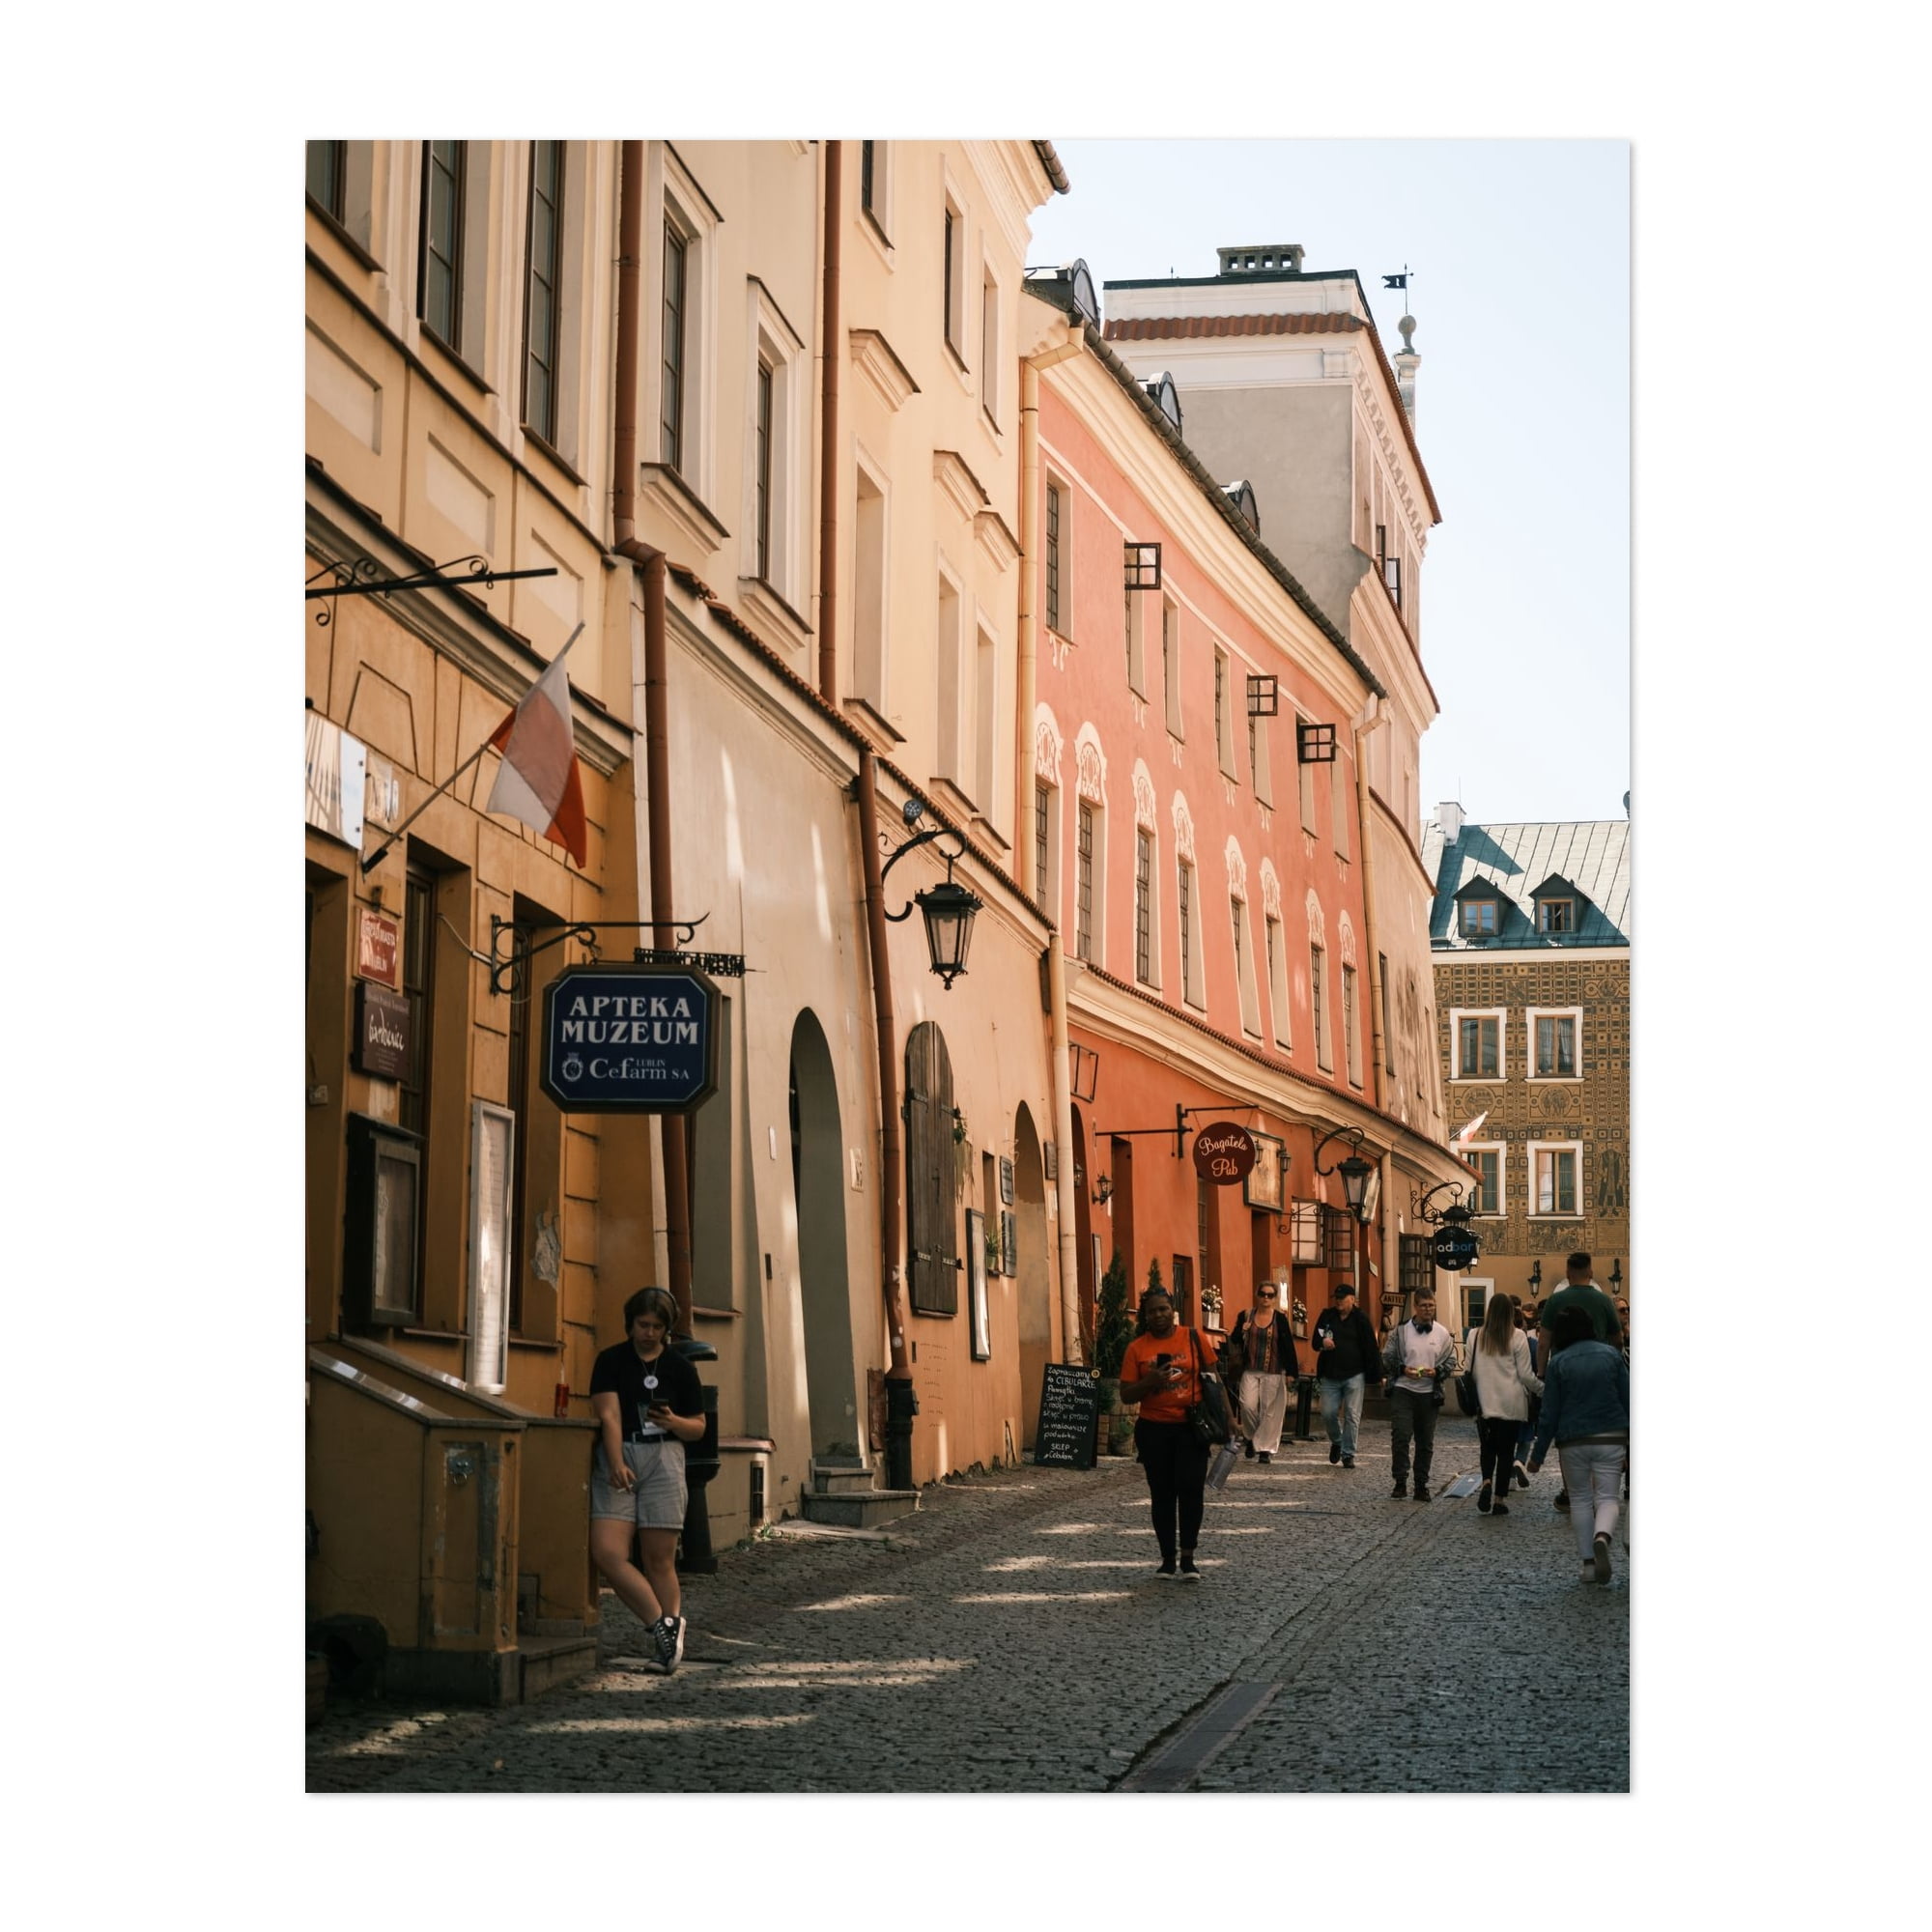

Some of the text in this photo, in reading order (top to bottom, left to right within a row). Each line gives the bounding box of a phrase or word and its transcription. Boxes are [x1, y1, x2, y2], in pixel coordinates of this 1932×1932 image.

[569, 996, 692, 1018] APTEKA
[560, 1020, 699, 1044] MUZEUM
[589, 1057, 690, 1080] Cefarm SA
[1211, 1157, 1238, 1178] Pub
[1436, 1240, 1474, 1253] adbar
[1050, 1442, 1070, 1451] SKLEP
